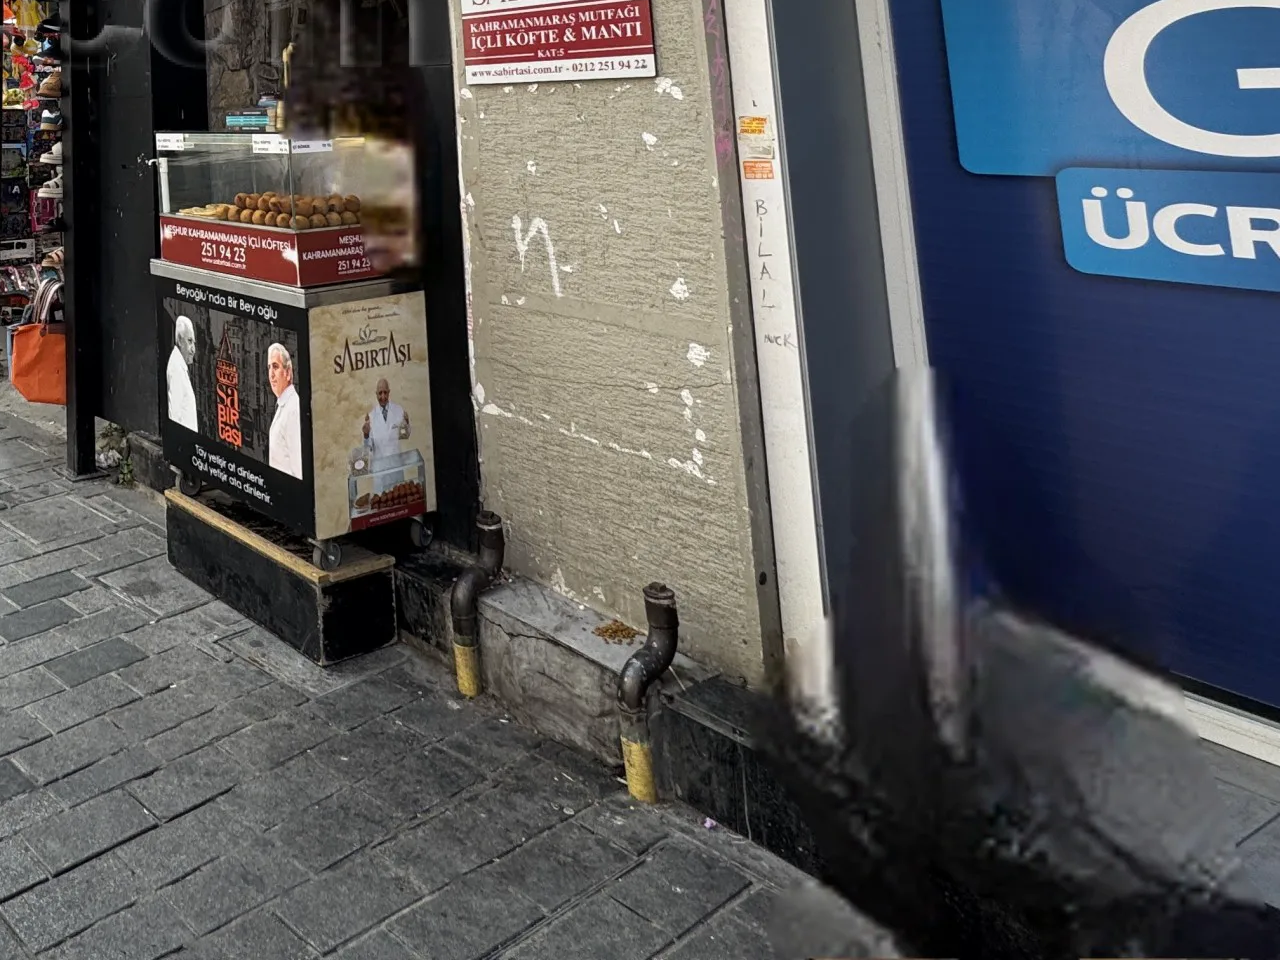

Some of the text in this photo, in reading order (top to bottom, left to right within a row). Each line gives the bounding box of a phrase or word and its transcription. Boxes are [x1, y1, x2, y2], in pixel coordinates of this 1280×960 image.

[470, 5, 641, 34] KAHRAMANMARAŞ MUTFAĞI
[471, 21, 643, 52] İÇLİ KÖFTE & MANTI
[537, 49, 565, 58] KAT:5
[471, 65, 564, 78] www.sabirtasi.com.tr
[571, 62, 596, 73] 0212
[598, 61, 615, 72] 251
[619, 60, 633, 70] 94
[634, 59, 647, 70] 22
[188, 228, 247, 248] KAHRAMANMARAŞ
[247, 234, 261, 249] İÇLİ
[338, 234, 362, 245] MEŞHU
[201, 241, 246, 262] 251 94 23
[302, 246, 364, 260] KAHRAMANMARAŞ
[337, 260, 350, 271] 251
[352, 259, 360, 269] 94
[176, 283, 278, 320] Beyoğlu'nda Bir Bey oğlu
[333, 330, 412, 375] SABIRTAŞI
[195, 444, 208, 460] Tay
[228, 462, 236, 472] at
[192, 455, 208, 472] Oğul
[229, 476, 242, 490] ata
